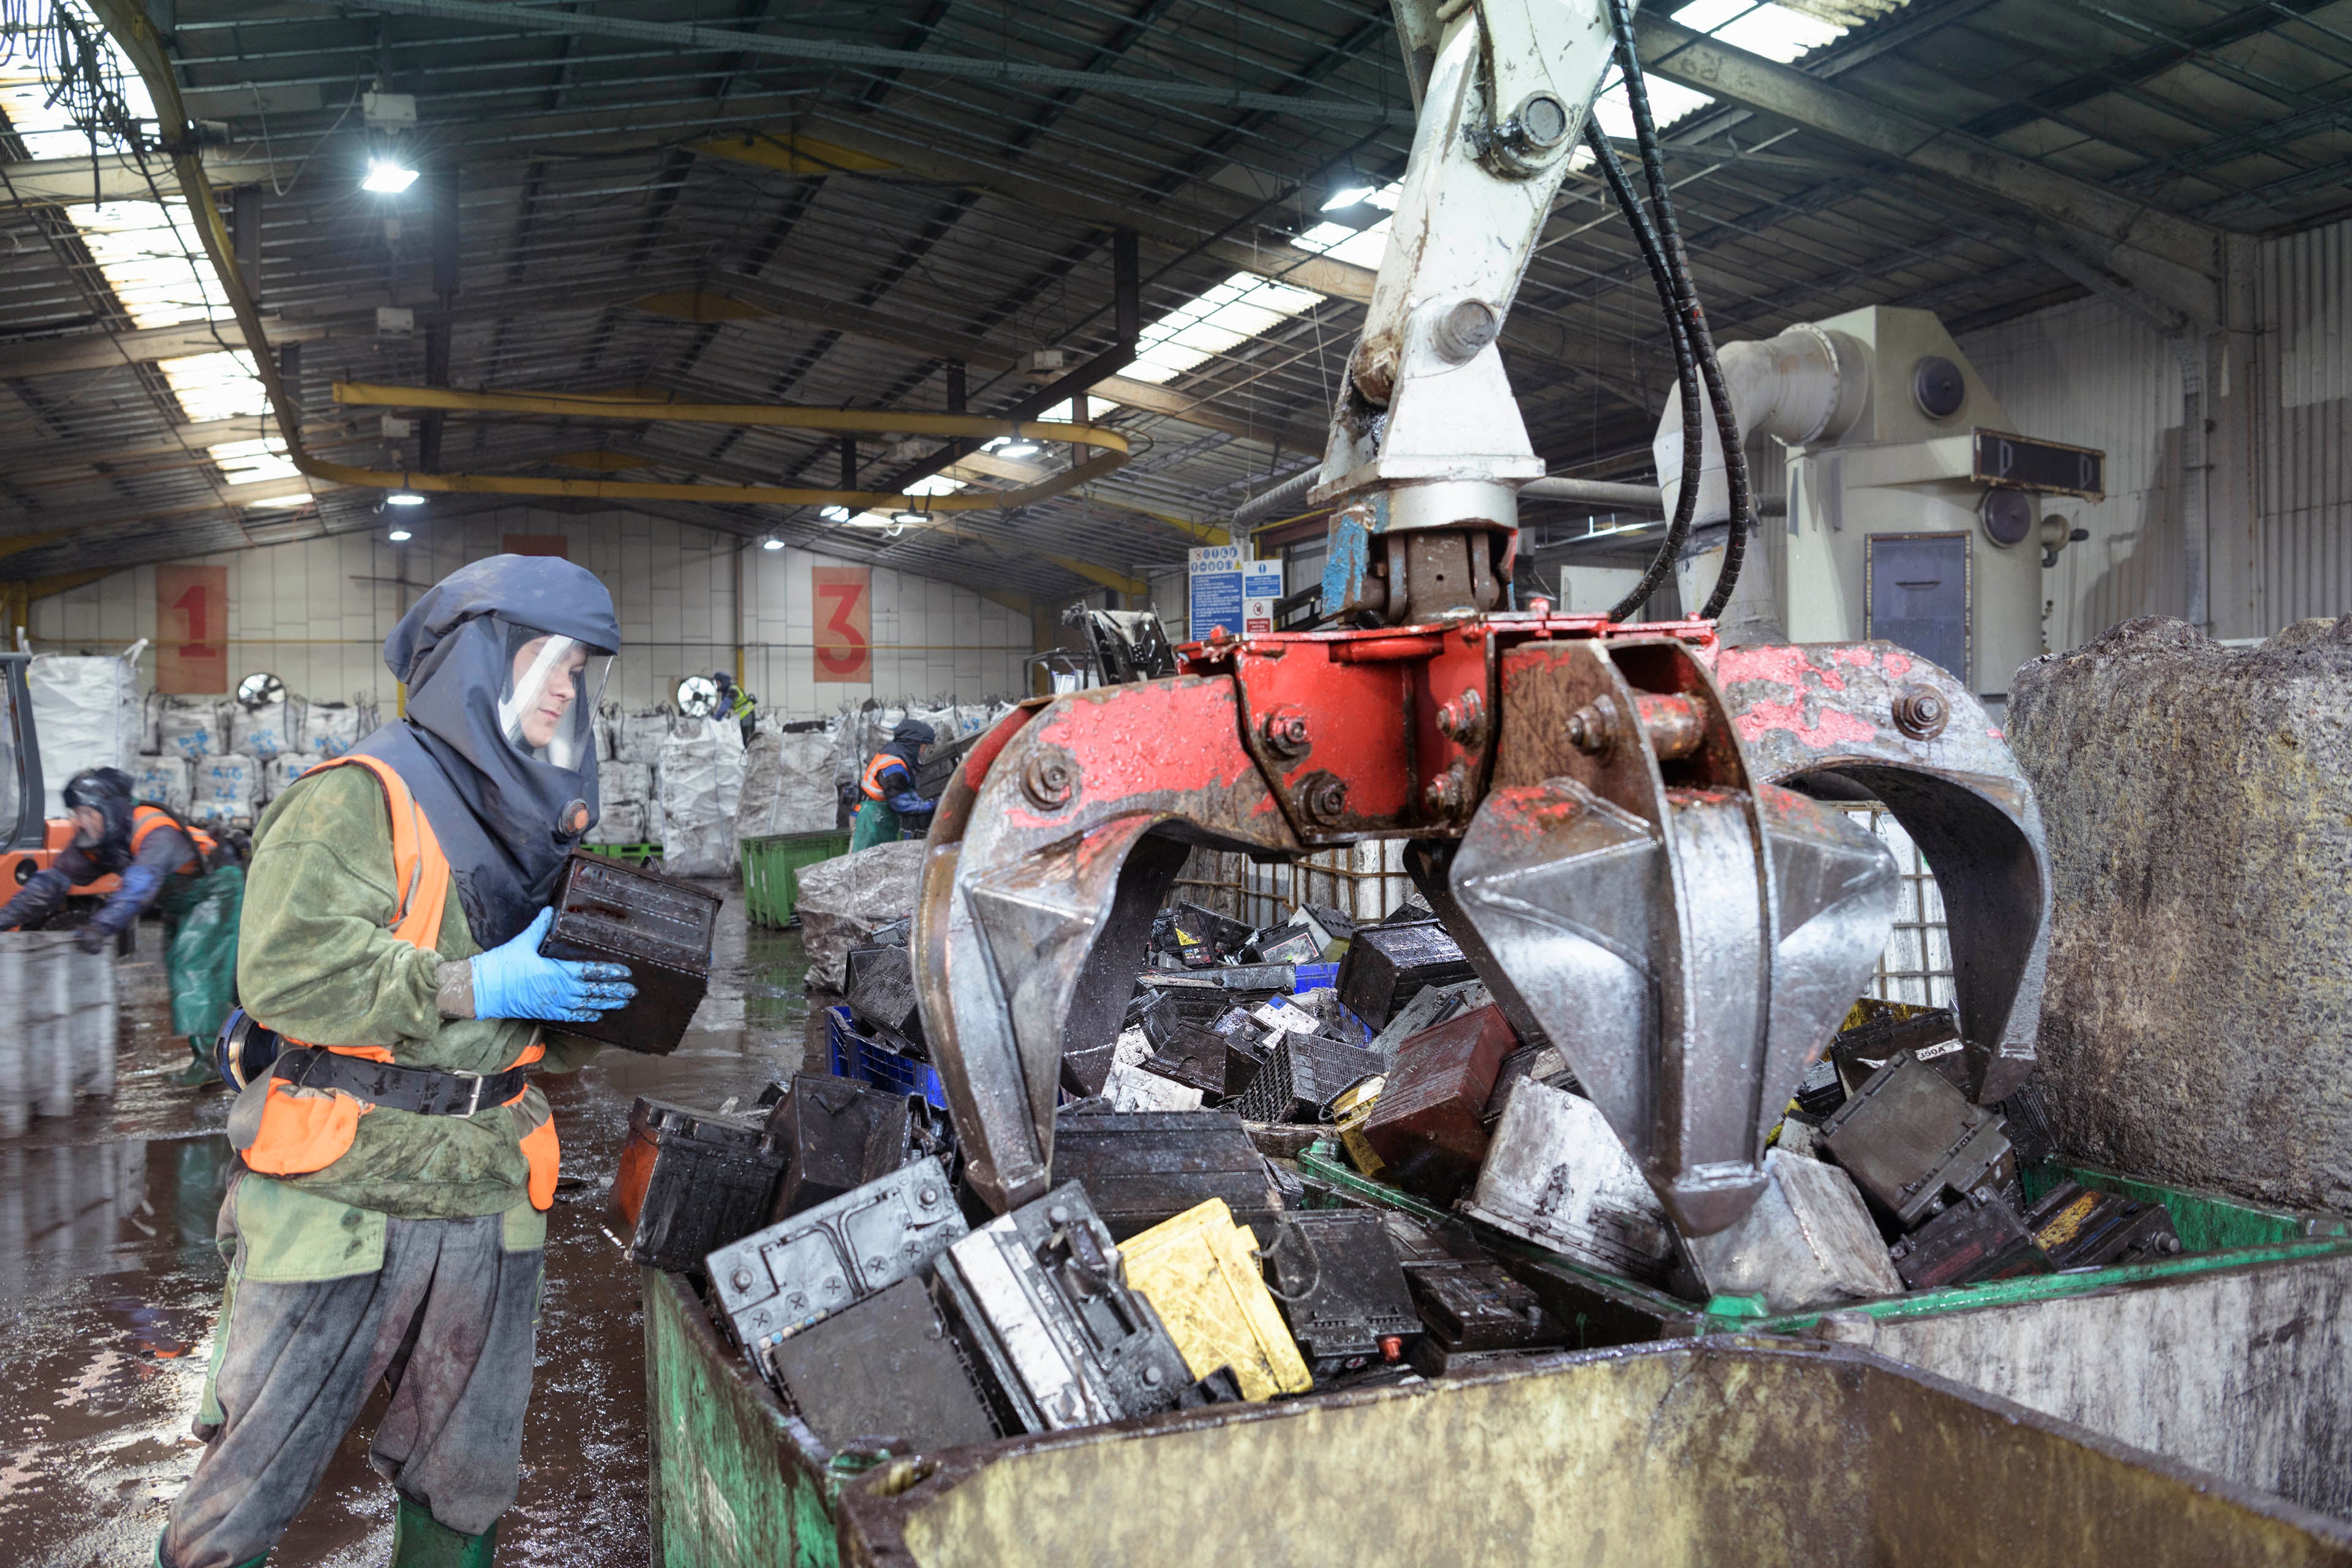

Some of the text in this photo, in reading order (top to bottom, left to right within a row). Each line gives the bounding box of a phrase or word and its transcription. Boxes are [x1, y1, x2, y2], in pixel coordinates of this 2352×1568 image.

[173, 586, 216, 657] 1
[816, 584, 867, 674] 3
[1919, 1046, 1946, 1058] 350A
